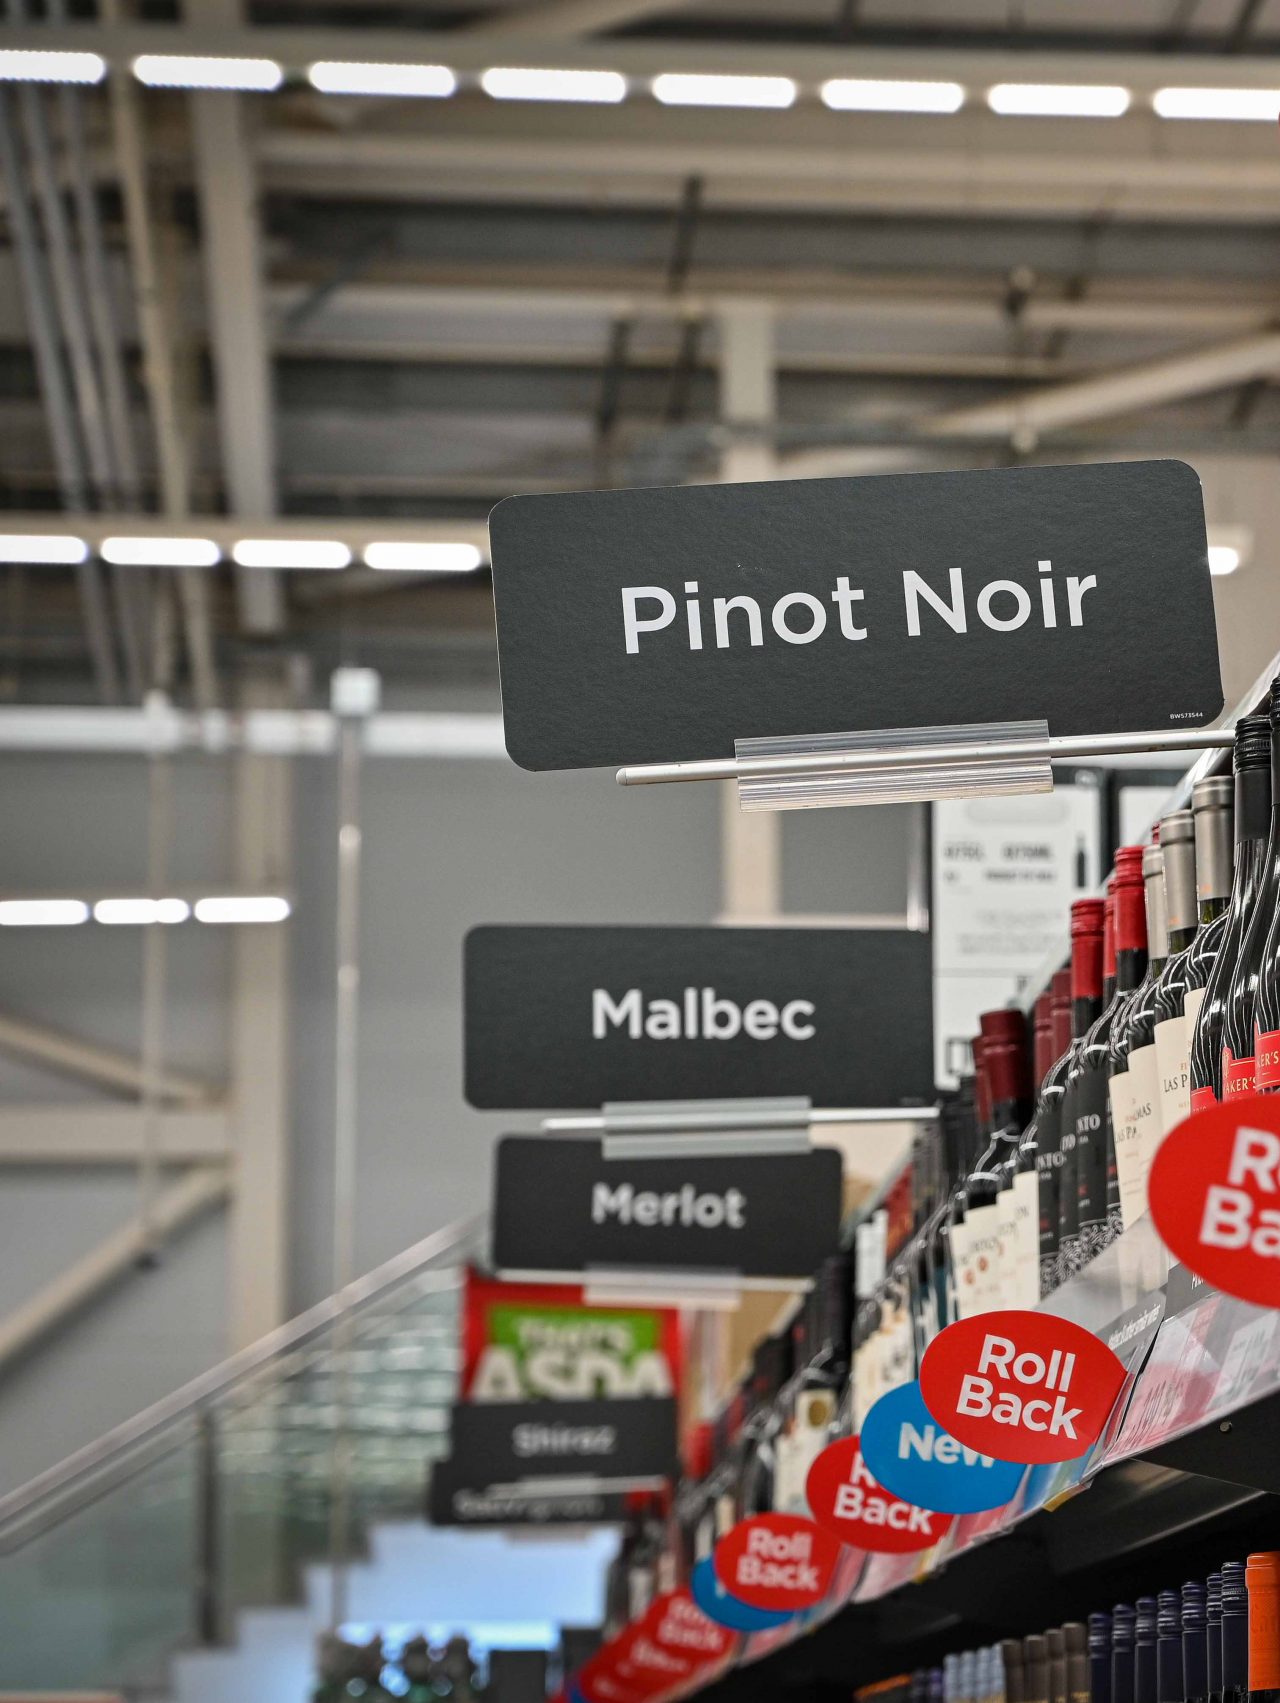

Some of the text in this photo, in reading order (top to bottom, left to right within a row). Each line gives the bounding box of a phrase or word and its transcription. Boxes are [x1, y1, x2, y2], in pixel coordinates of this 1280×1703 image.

[621, 559, 1097, 655] Pinot Noir
[592, 987, 816, 1040] Malbec
[592, 1182, 747, 1228] Merlot
[977, 1333, 1076, 1393] Roll
[956, 1373, 1083, 1440] Back
[833, 1484, 934, 1535] Back
[747, 1527, 813, 1563] Roll
[736, 1554, 819, 1591] Back
